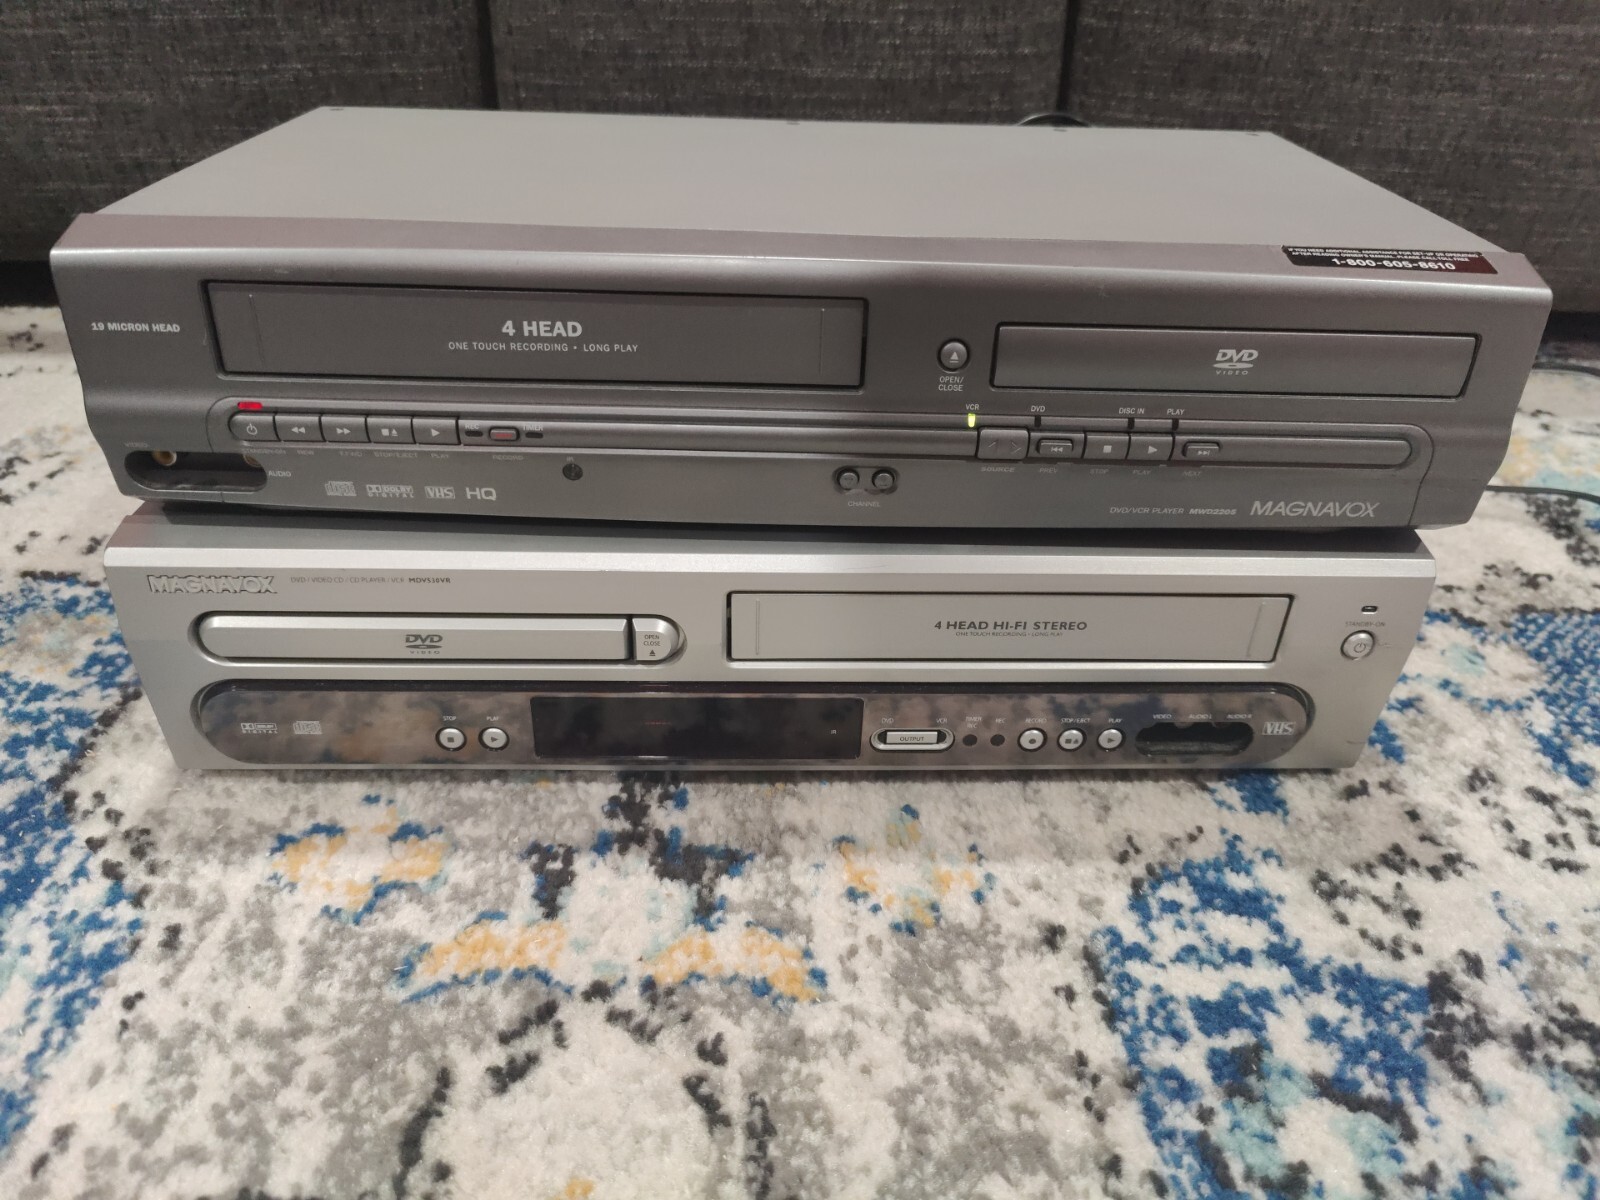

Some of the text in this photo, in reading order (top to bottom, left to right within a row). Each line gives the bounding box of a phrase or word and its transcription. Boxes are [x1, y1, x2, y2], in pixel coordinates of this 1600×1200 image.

[1331, 258, 1456, 270] 1-800-605-8610
[91, 322, 180, 333] 19 MICRON HEAD
[501, 320, 583, 337] 4 HEAD
[448, 341, 639, 352] ONE TOUCH RECORDING LONG PLAY
[1215, 349, 1259, 363] DVD
[268, 470, 292, 478] AUDIO
[426, 486, 455, 499] VHS
[466, 487, 497, 501] HQ
[1109, 506, 1150, 514] DVD/VCR
[1250, 500, 1381, 518] MAGNAVOX
[147, 575, 277, 593] MAGNAVOX
[934, 621, 1088, 631] 4 HEAD HI-FI STEREO
[405, 634, 444, 644] DVD
[1263, 721, 1296, 735] VHS
